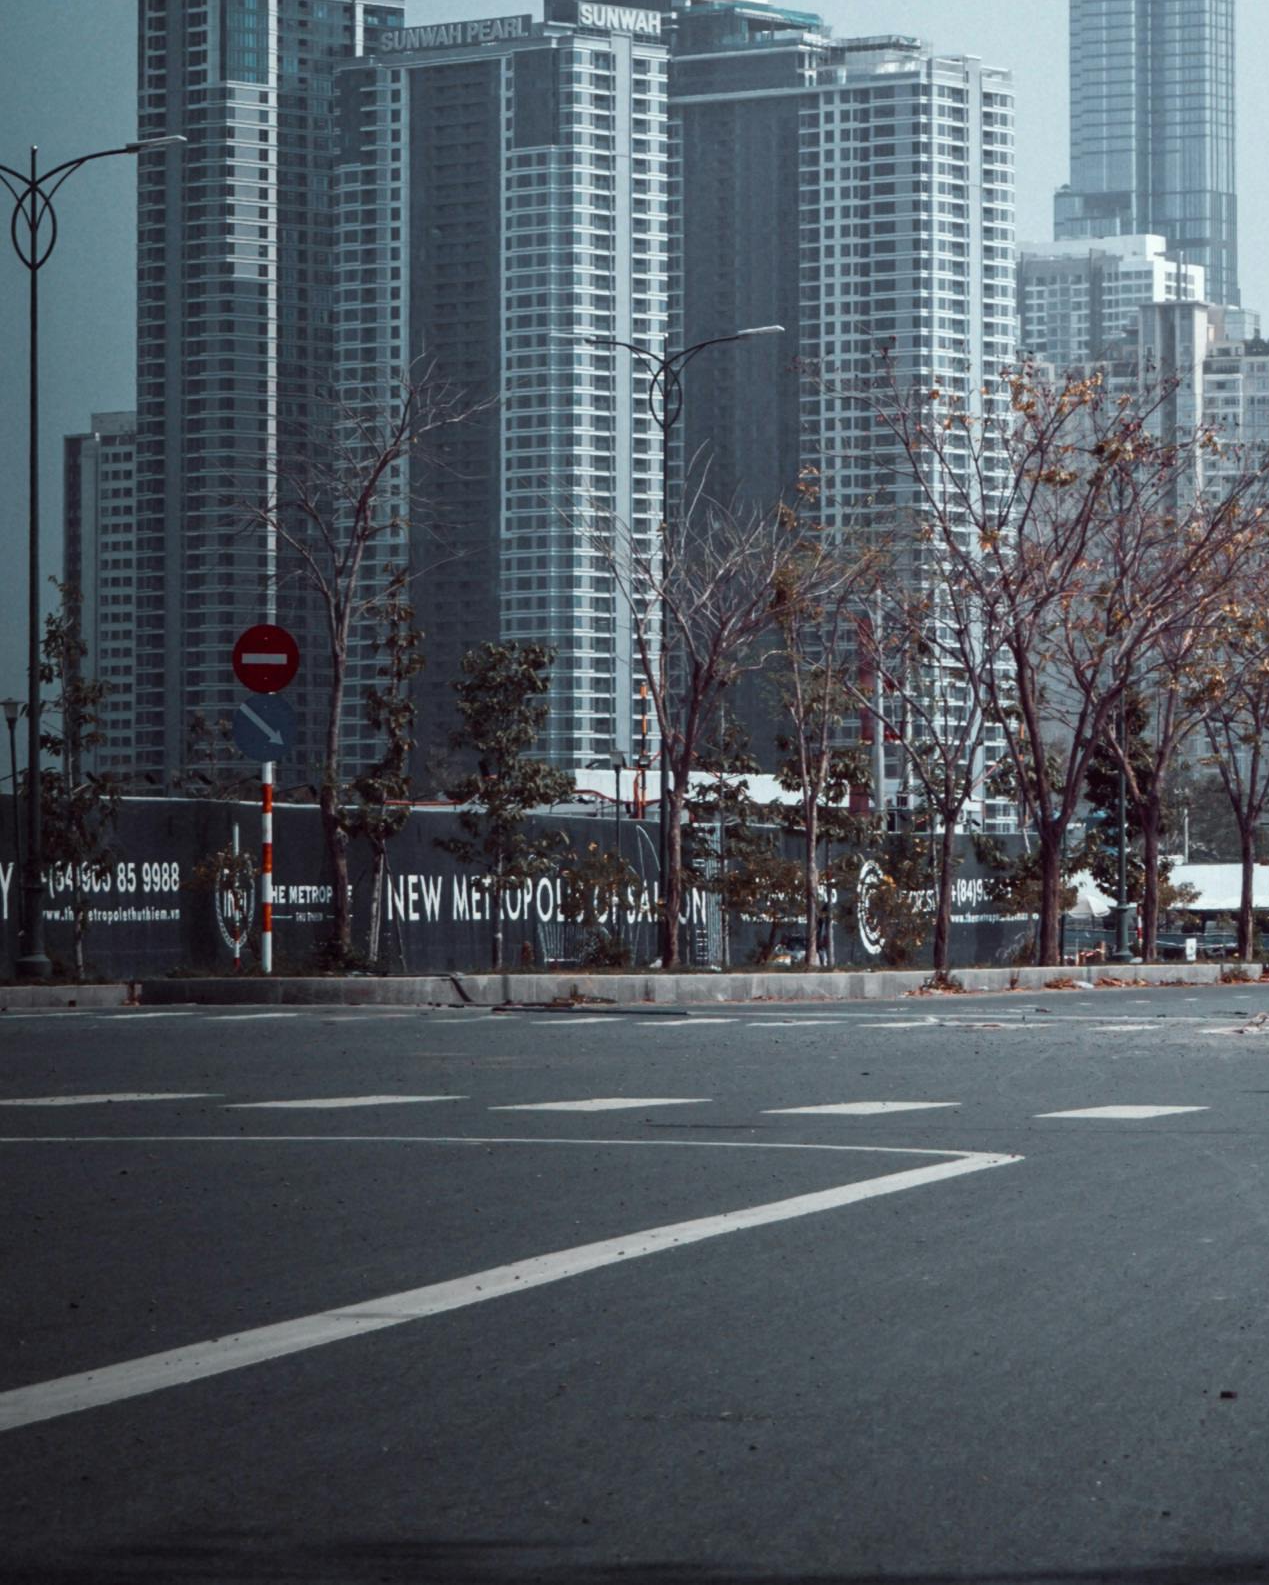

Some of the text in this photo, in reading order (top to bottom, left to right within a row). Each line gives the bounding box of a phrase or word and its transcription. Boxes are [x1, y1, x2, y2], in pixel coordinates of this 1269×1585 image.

[381, 17, 529, 51] SUNWAH PEARL
[581, 4, 661, 34] SUNWAH
[117, 861, 136, 893] 85
[142, 861, 180, 893] 9988
[289, 885, 353, 904] METROPE
[387, 874, 442, 922] NEW
